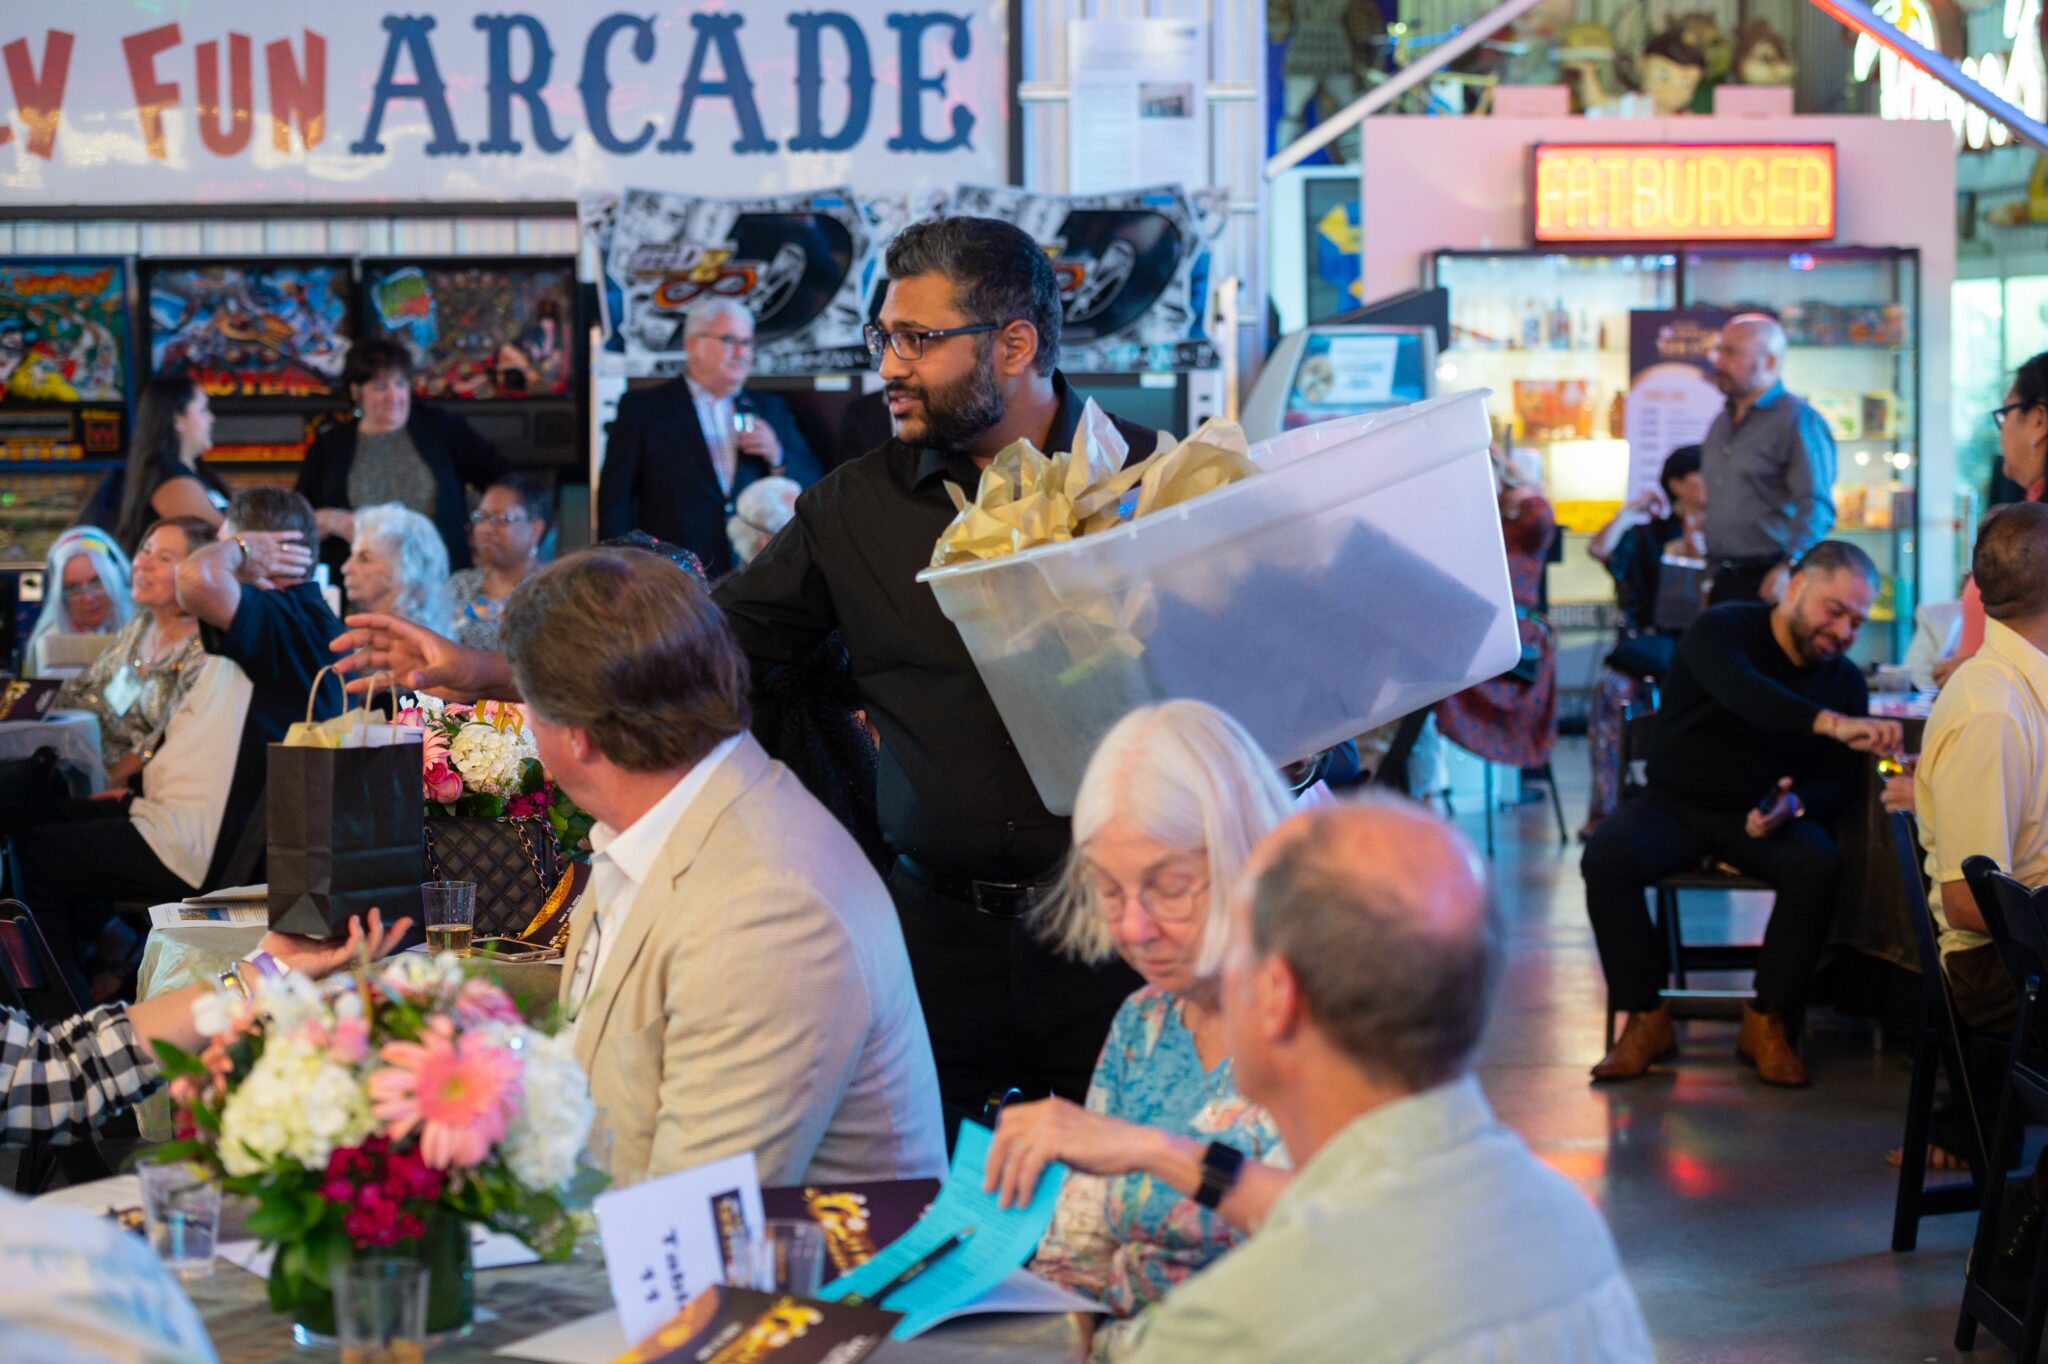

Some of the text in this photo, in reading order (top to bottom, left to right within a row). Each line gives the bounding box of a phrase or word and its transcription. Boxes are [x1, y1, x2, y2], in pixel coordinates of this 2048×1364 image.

[0, 29, 75, 160] Y
[122, 20, 328, 160] FUN
[350, 11, 976, 156] ARCADE
[1537, 154, 1830, 229] FATBURGER
[661, 1226, 690, 1310] Tabl
